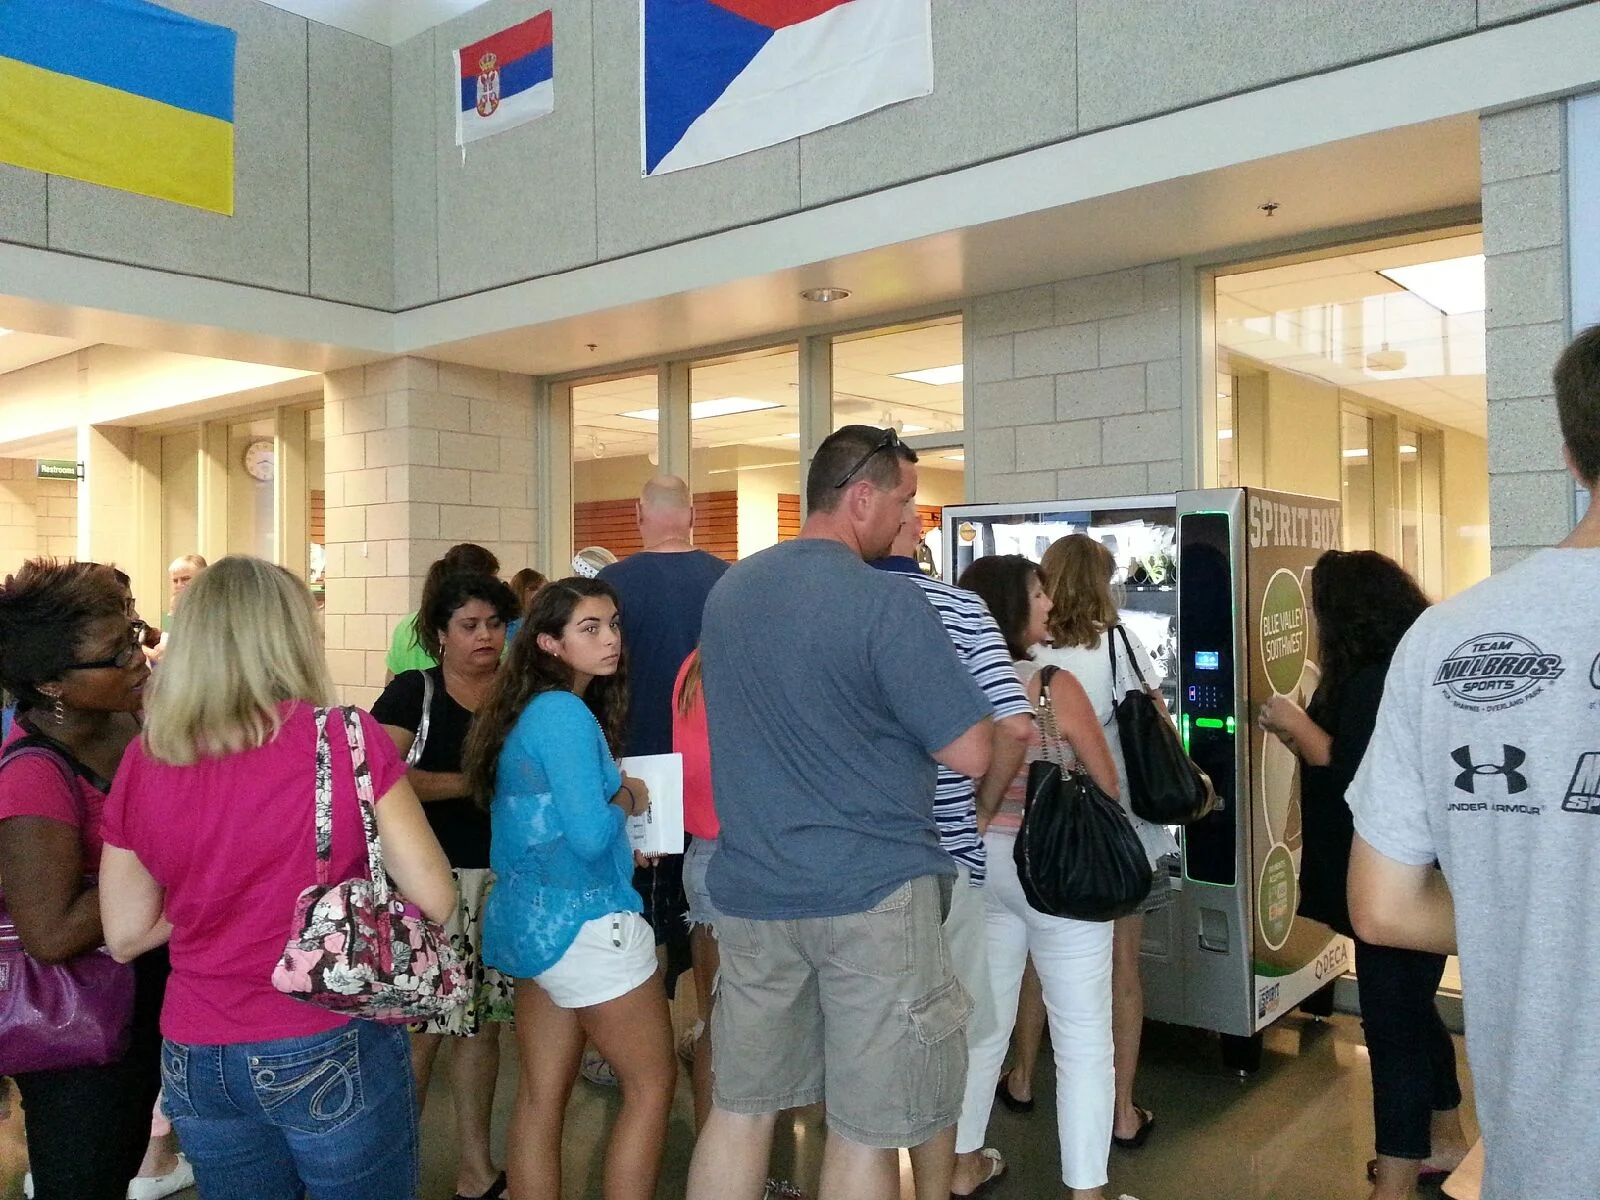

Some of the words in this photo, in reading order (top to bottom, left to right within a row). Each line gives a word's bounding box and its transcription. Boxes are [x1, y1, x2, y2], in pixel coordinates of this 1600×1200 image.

[41, 465, 74, 474] Restrooms
[1250, 496, 1308, 549] SPIRIT
[1311, 507, 1341, 550] BOX
[1263, 614, 1280, 637] BLUE
[1280, 608, 1303, 631] VALLEY
[1267, 637, 1303, 662] SOUTHWEST
[1472, 641, 1514, 653] TEAM
[1462, 680, 1515, 692] SPORTS
[1487, 699, 1524, 713] OVERLAND
[1324, 943, 1348, 973] DECA
